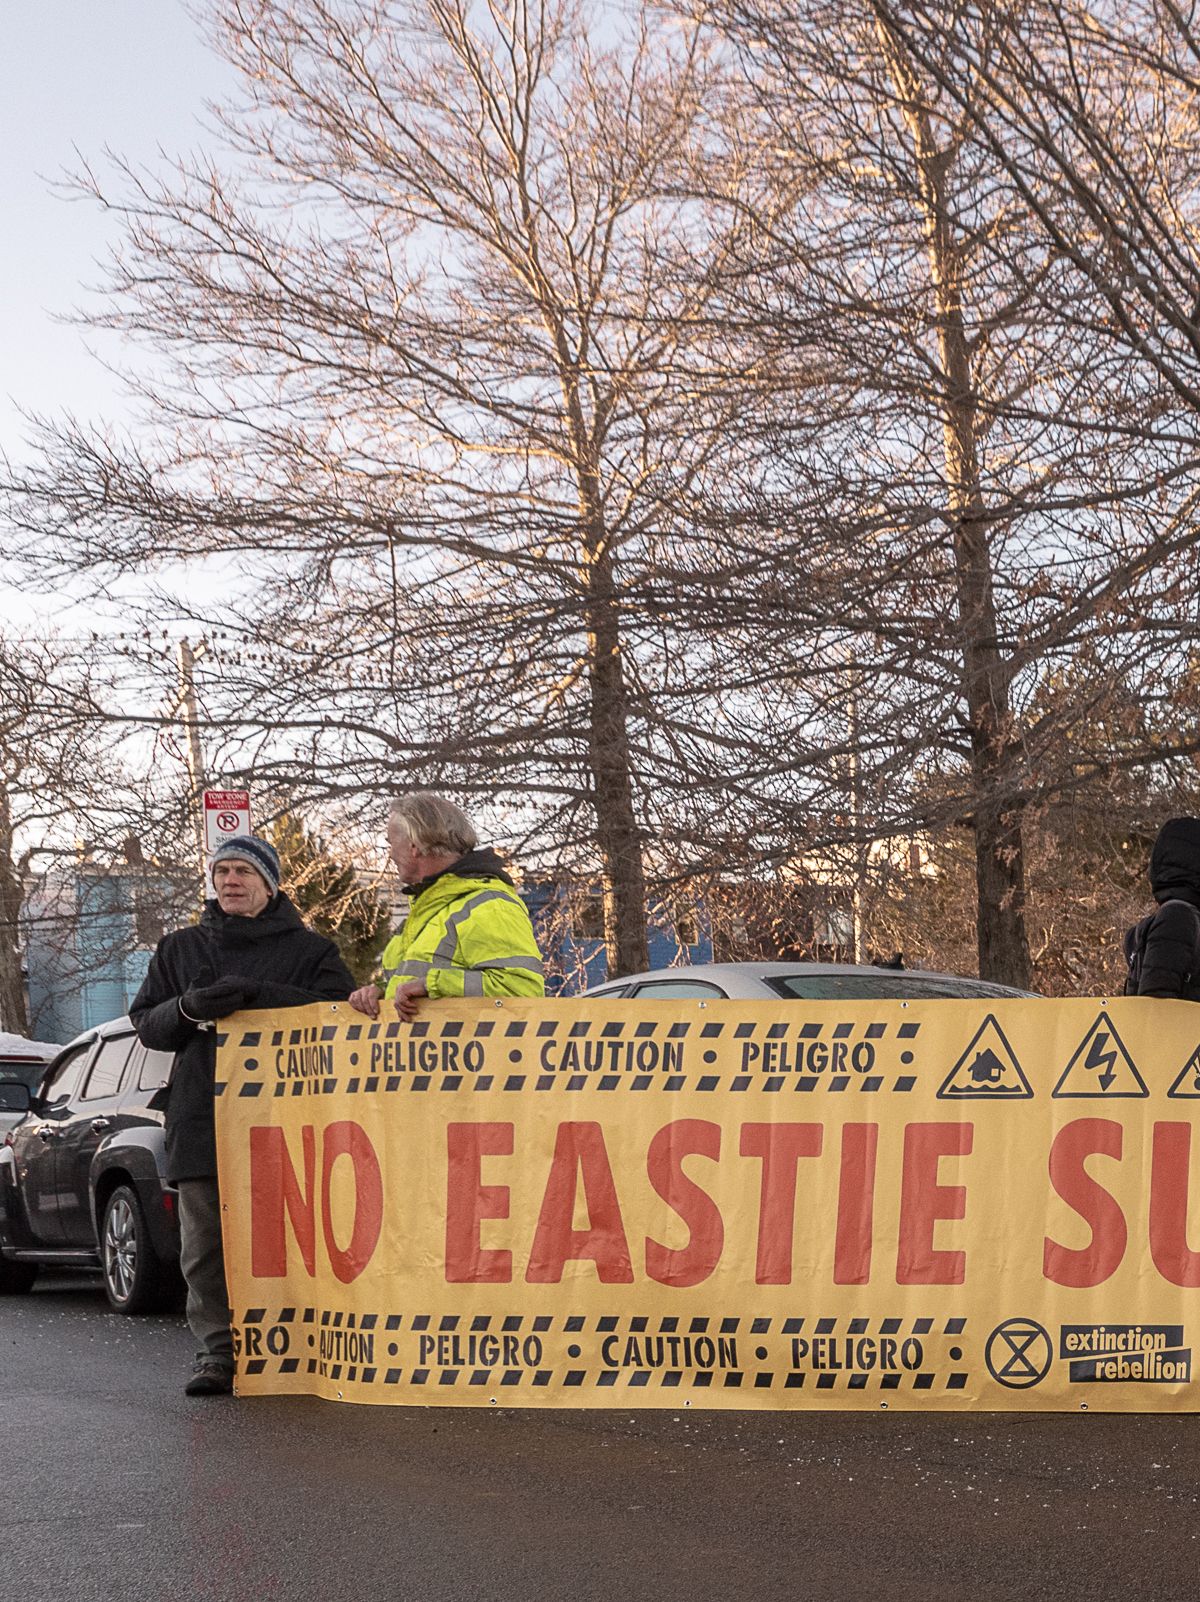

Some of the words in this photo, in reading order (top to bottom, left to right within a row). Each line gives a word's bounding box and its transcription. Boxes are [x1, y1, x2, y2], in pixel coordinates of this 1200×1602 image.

[370, 1041, 484, 1073] PELIGRO
[541, 1040, 683, 1072] CAUTION
[741, 1042, 875, 1073] PELIGRO
[250, 1121, 383, 1284] NO
[445, 1119, 974, 1287] EASTIE
[320, 1330, 374, 1363] AUTION
[419, 1335, 542, 1367] PELIGRO
[601, 1336, 738, 1369] CAUTION
[792, 1337, 923, 1370] PELIGRO
[1065, 1327, 1166, 1351] extinction
[1095, 1350, 1187, 1379] rebellion
